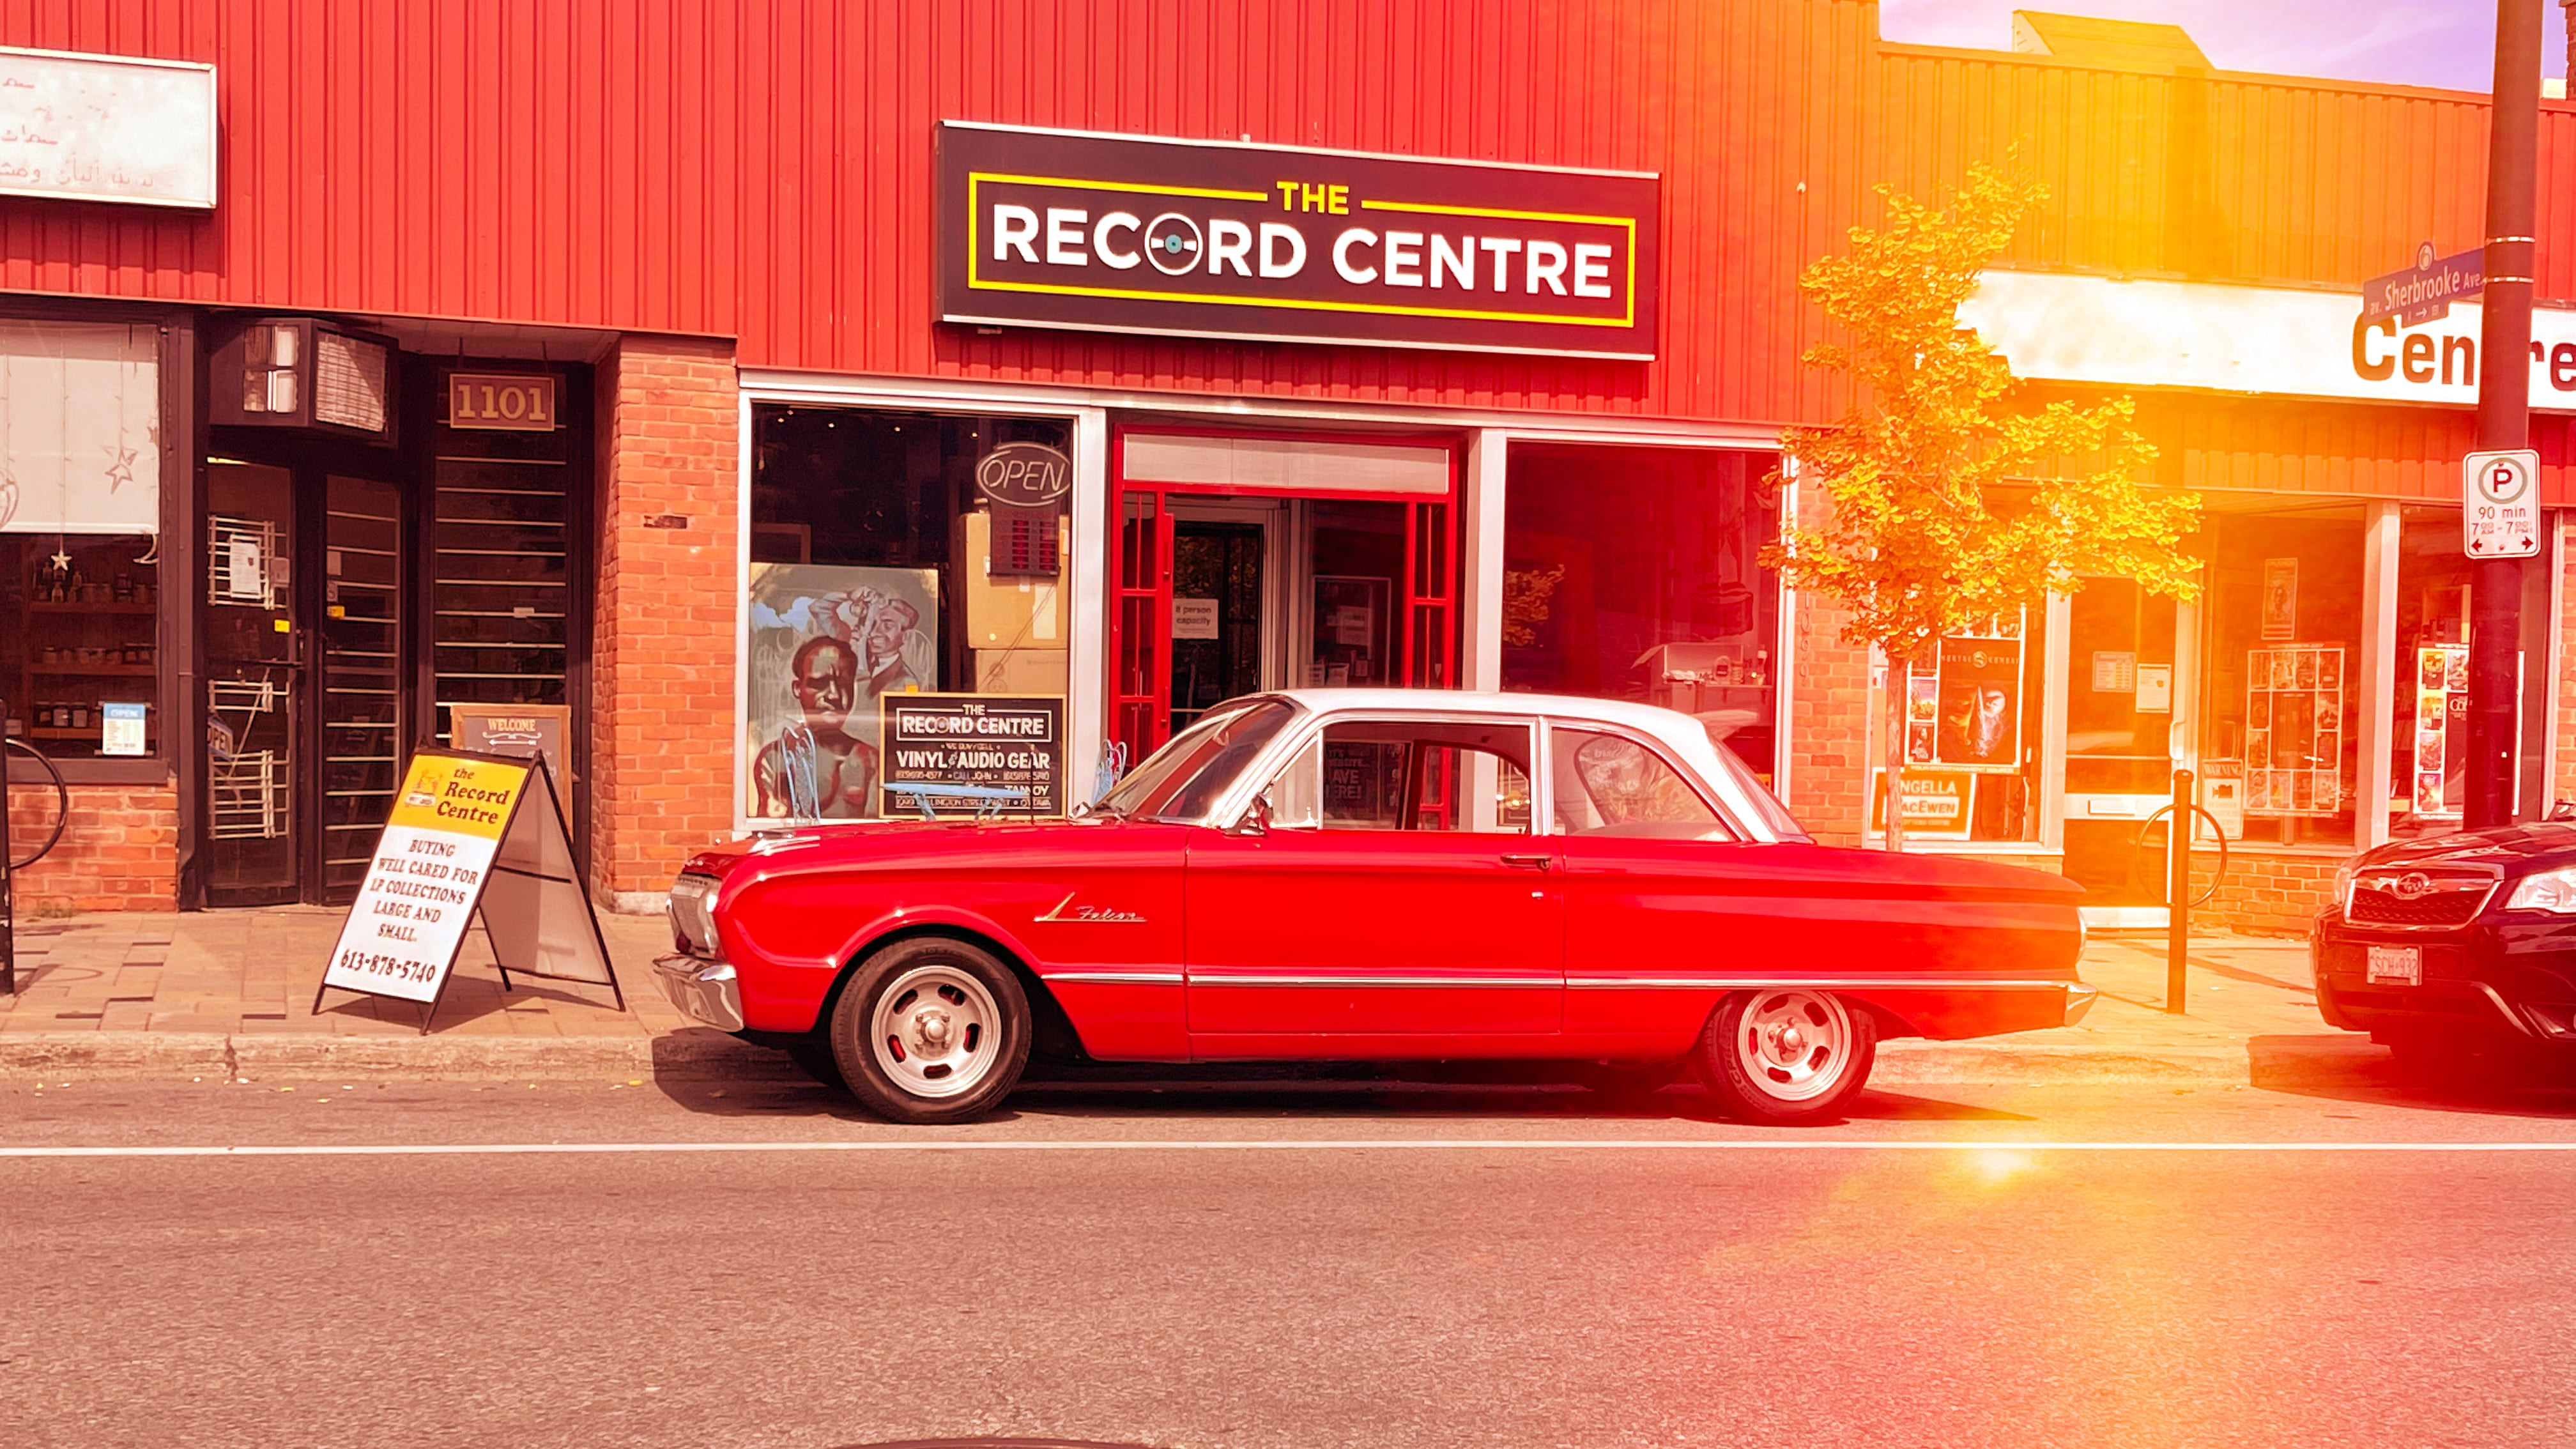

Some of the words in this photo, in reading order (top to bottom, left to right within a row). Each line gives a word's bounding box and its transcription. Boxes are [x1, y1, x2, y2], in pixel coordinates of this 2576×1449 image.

[1276, 181, 1349, 215] THE
[994, 204, 1306, 278] RECORD
[1333, 228, 1612, 298] CENTRE
[2385, 266, 2460, 311] Sherbrooke
[457, 384, 546, 422] 1101
[983, 459, 1066, 491] OPEN
[2494, 469, 2513, 493] P
[2478, 507, 2495, 519] 90
[2502, 505, 2526, 518] min
[1176, 617, 1211, 626] capacity
[1183, 607, 1212, 615] person
[963, 704, 985, 716] THE
[487, 718, 537, 732] WELCOME
[902, 716, 974, 734] RECORD
[977, 717, 1044, 735] CENTRE
[896, 750, 948, 768] VINYL
[956, 751, 1005, 769] AUDIO
[1008, 752, 1050, 769] GEAR
[454, 768, 475, 780] the
[445, 781, 510, 805] Record
[1900, 780, 1957, 795] NGELLA
[436, 801, 499, 824] Centre
[408, 839, 456, 857] BUYING
[378, 857, 406, 873] WELL
[409, 861, 450, 879] CARED
[450, 867, 479, 885] FOR
[369, 878, 385, 892] LP
[386, 880, 467, 905] COLLECTIONS
[373, 900, 413, 919] LARGE
[413, 907, 442, 923] AND
